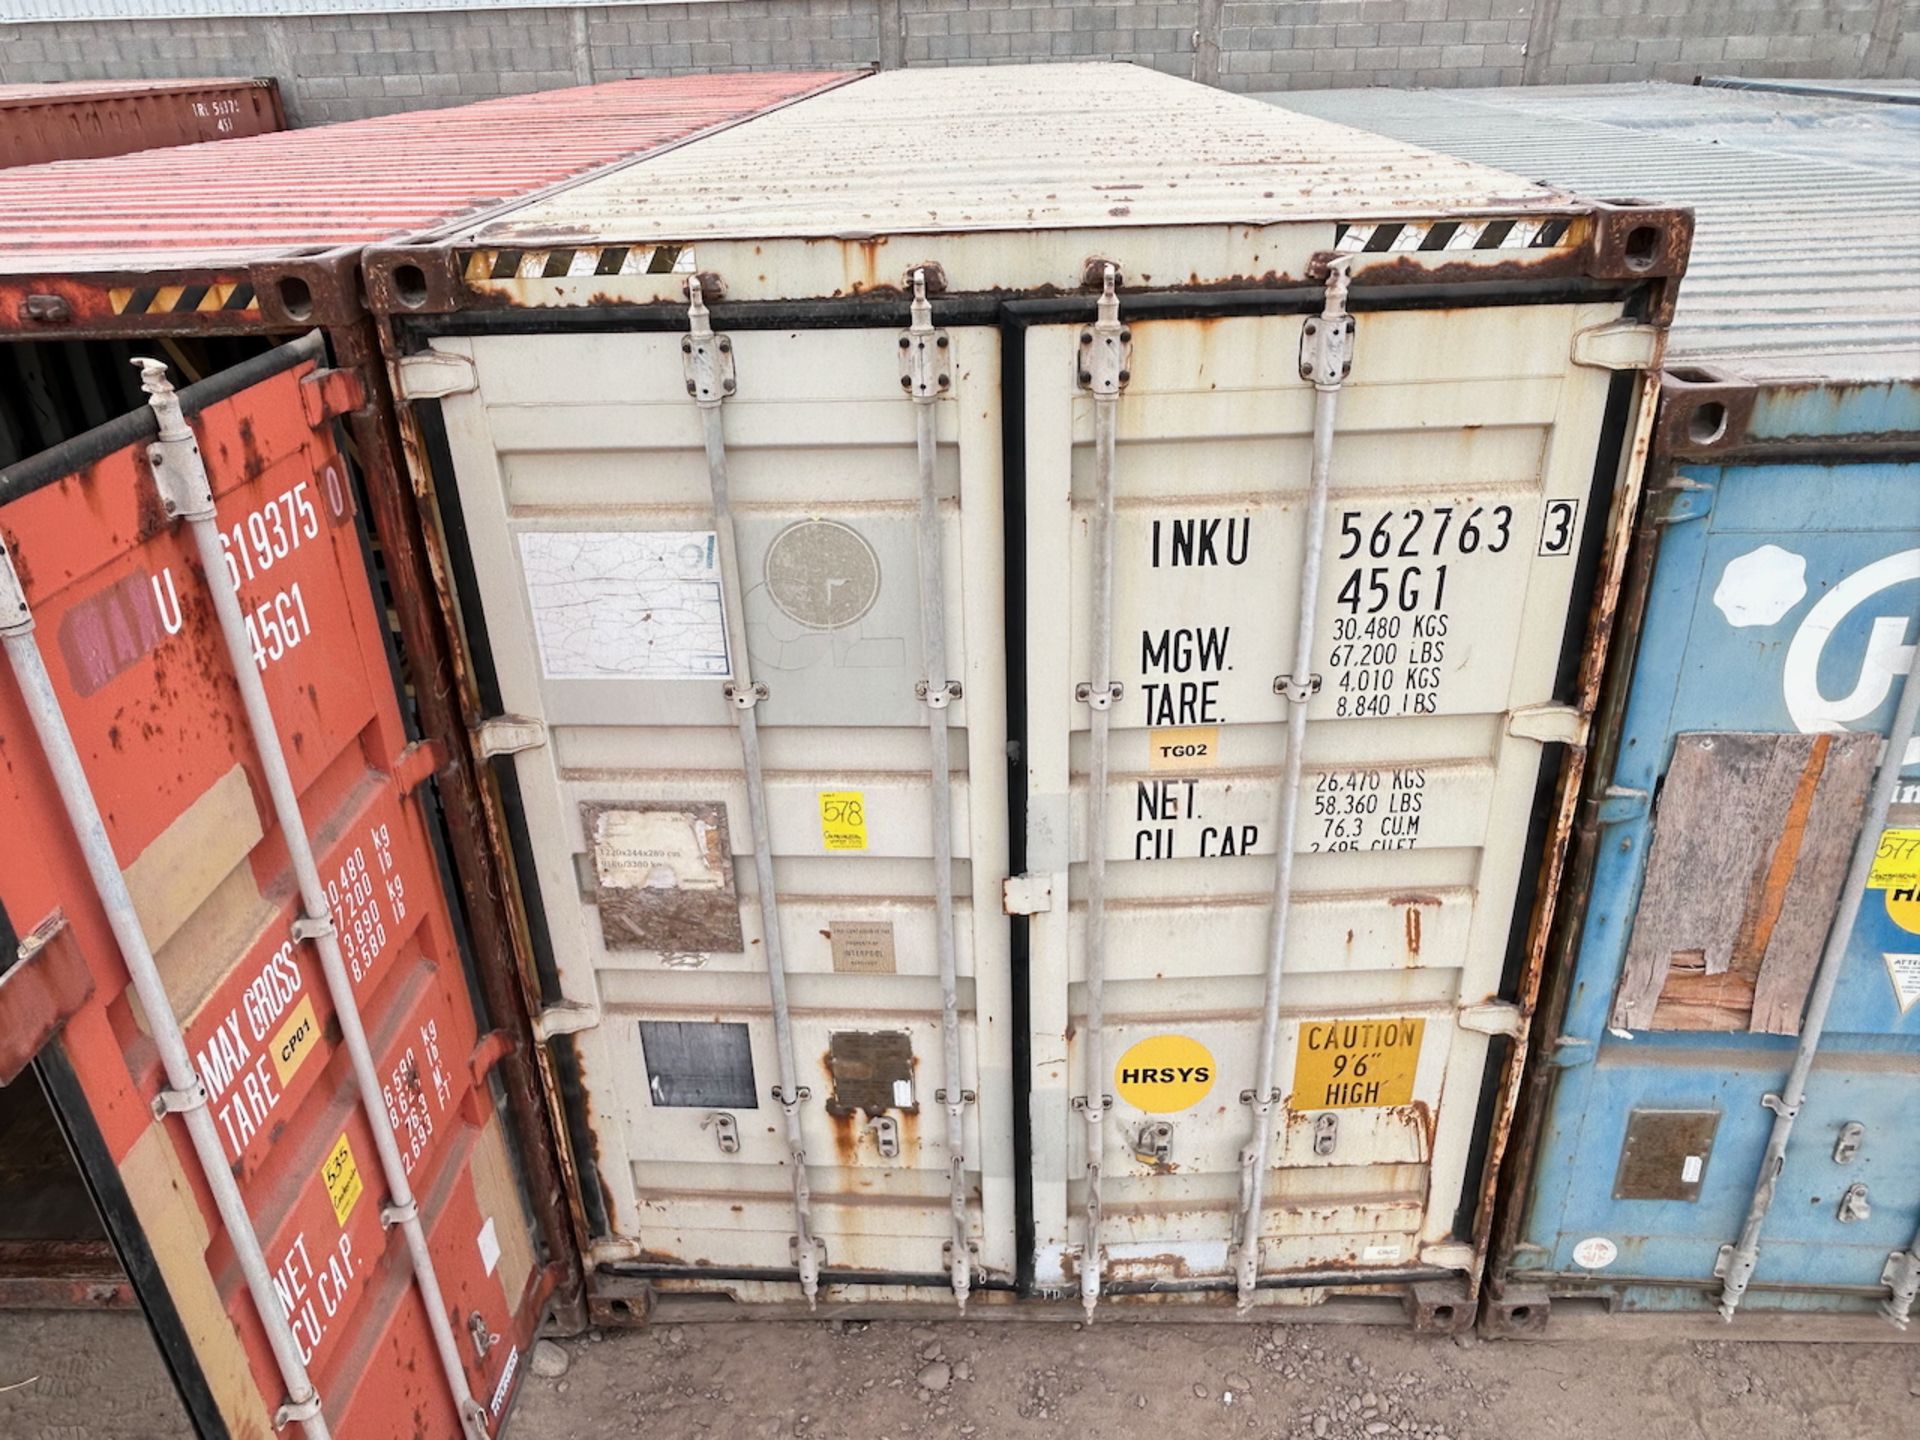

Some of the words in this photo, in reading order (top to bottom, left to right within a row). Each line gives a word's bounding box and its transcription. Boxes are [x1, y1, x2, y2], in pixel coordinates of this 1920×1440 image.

[1152, 517, 1250, 567] INKU
[1339, 506, 1513, 559] 562763
[1545, 503, 1572, 551] 3
[1337, 565, 1447, 614] 45G1
[244, 582, 311, 670] 45G1
[1142, 626, 1233, 674] MGW.
[1413, 614, 1448, 638] KGS
[1410, 641, 1444, 664] LBS
[1141, 681, 1226, 725] TARE.
[1406, 667, 1440, 689] KGS
[1160, 744, 1207, 758] TG02
[1137, 779, 1202, 821] NET.
[1392, 769, 1426, 789] KGS
[1389, 793, 1423, 813] LBS
[823, 800, 863, 826] 578
[371, 824, 390, 850] kg
[1324, 818, 1363, 839] 76.3
[378, 848, 392, 875] lb
[1876, 837, 1920, 859] 577
[386, 874, 404, 900] kg
[392, 898, 406, 925] lb
[196, 1008, 251, 1104] MAX
[242, 941, 302, 1042] GROSS
[420, 1019, 437, 1046] kg
[281, 1017, 310, 1062] CP01
[1308, 1024, 1416, 1050] CAUTION
[426, 1042, 439, 1067] lb
[1122, 1067, 1210, 1084] HRSYS
[218, 1053, 280, 1157] TARE
[1325, 1081, 1380, 1106] HIGH
[273, 1232, 313, 1320] NET
[292, 1298, 327, 1366] CU.
[318, 1233, 363, 1317] CAP.
